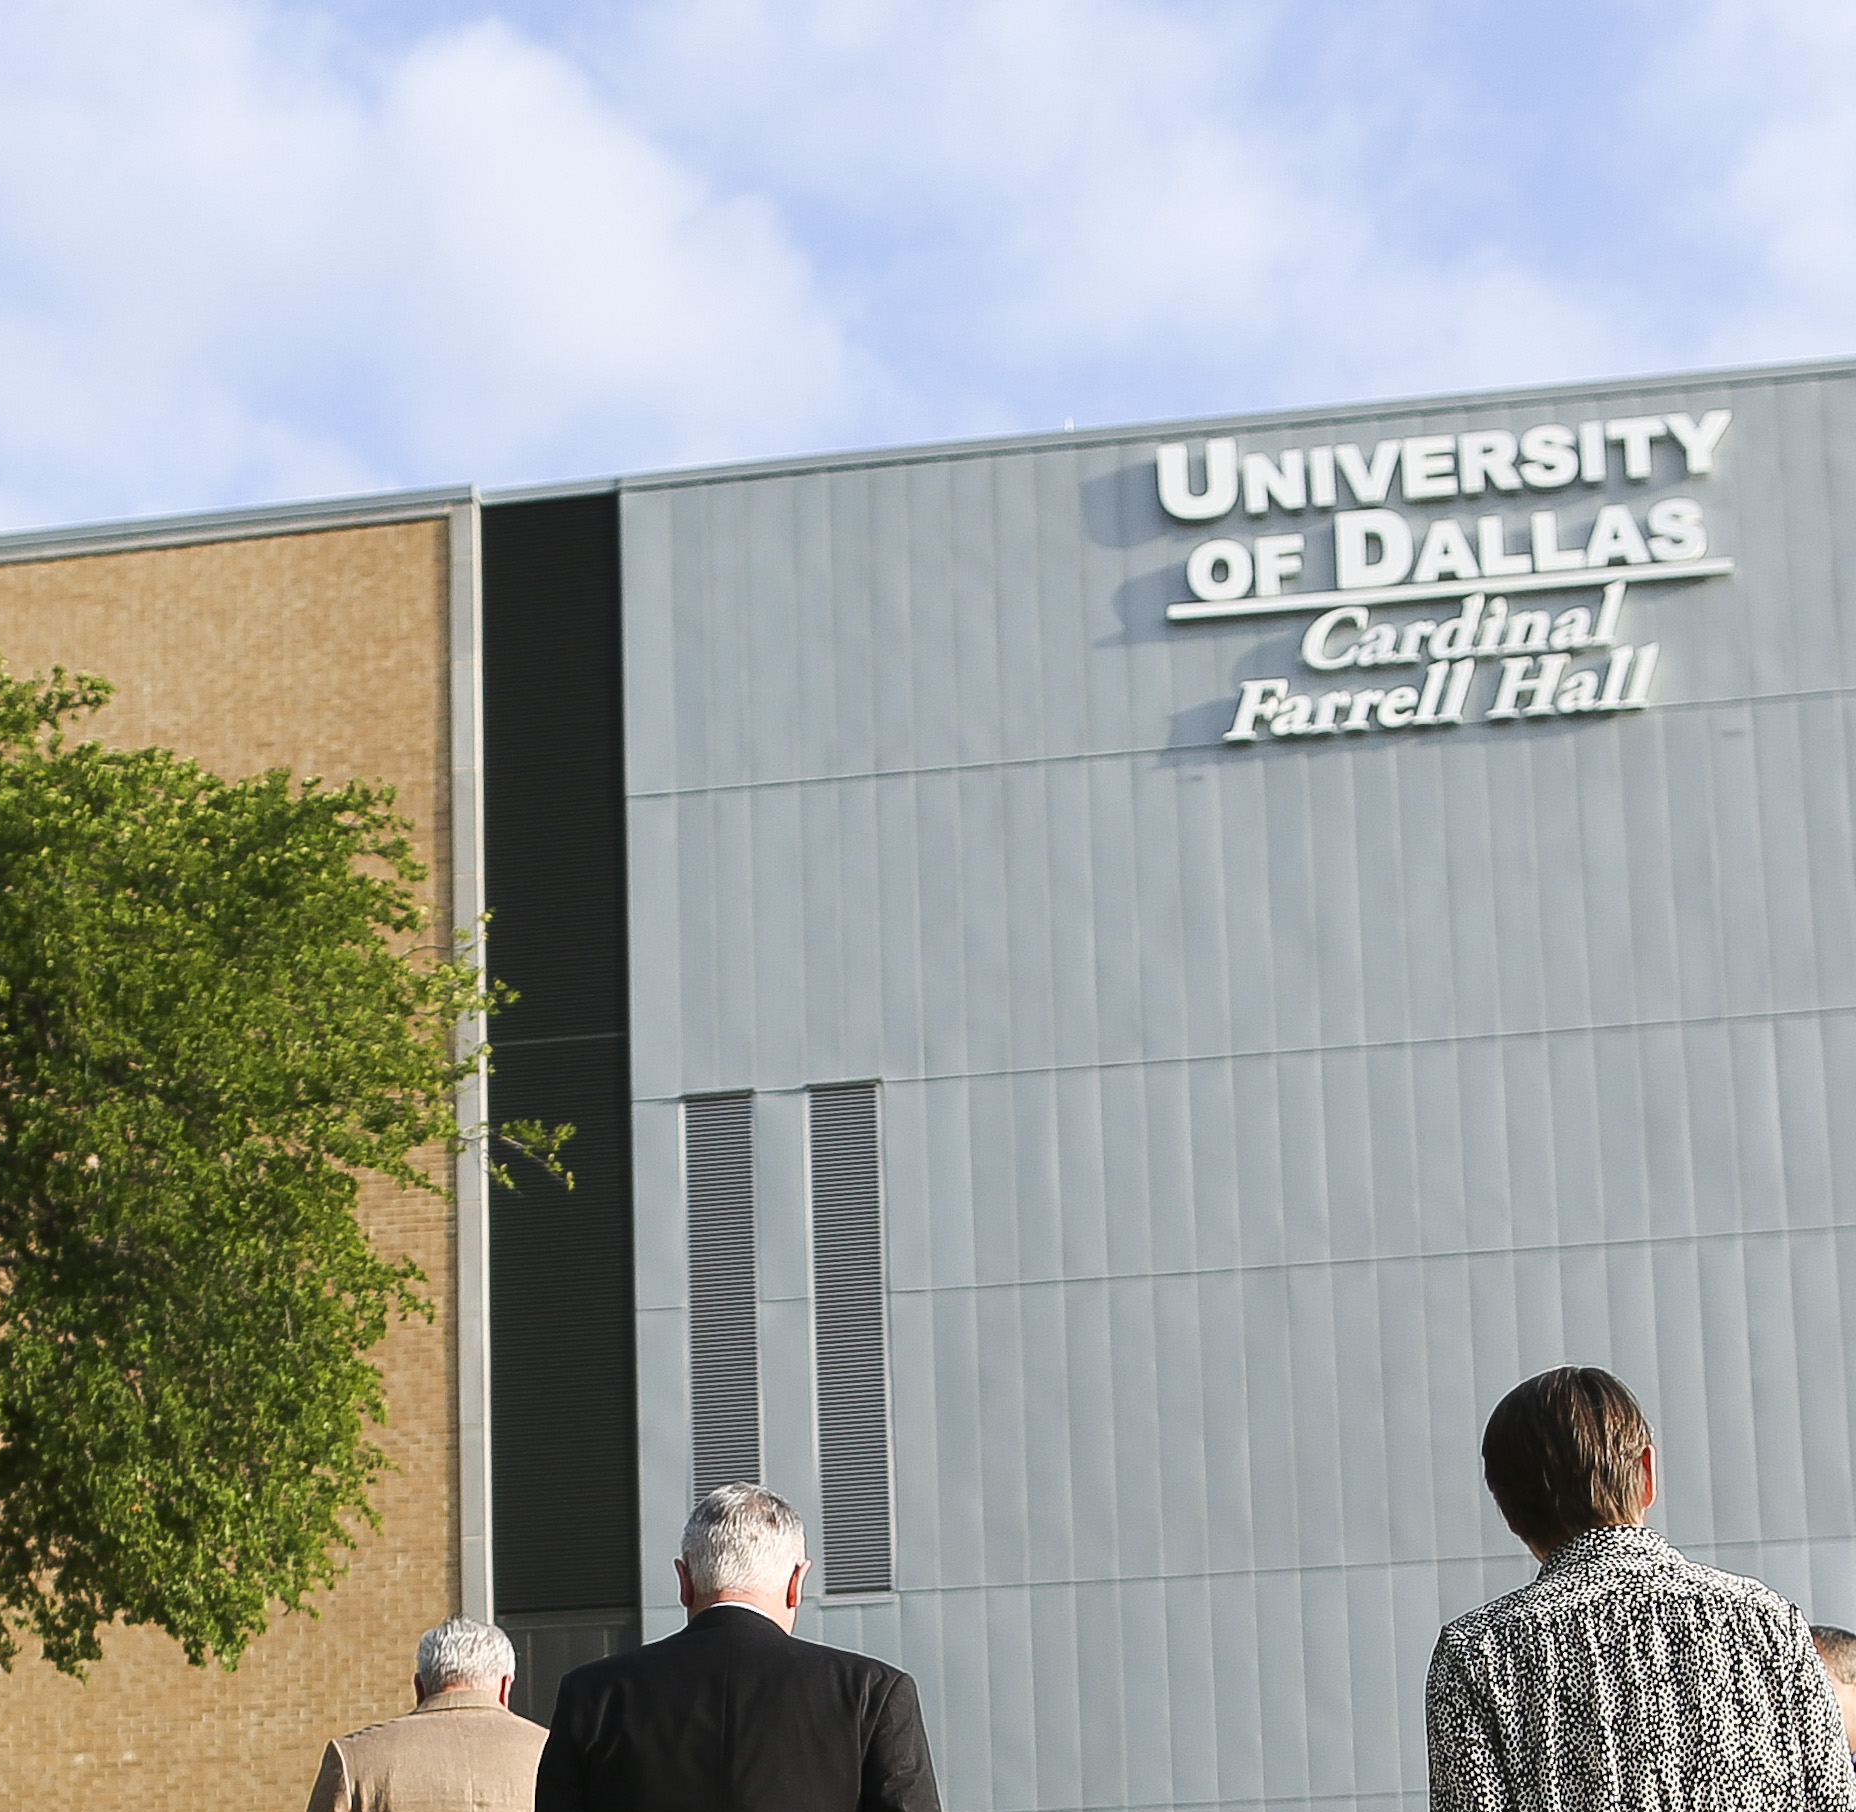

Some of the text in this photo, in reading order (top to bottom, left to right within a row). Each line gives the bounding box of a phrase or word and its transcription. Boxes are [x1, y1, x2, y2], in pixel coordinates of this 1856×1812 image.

[1155, 408, 1733, 520] UNIVERSITY
[1185, 496, 1709, 601] OF DALLAS
[1300, 579, 1627, 672] Cardinal
[1221, 641, 1661, 742] Farrell Hall
